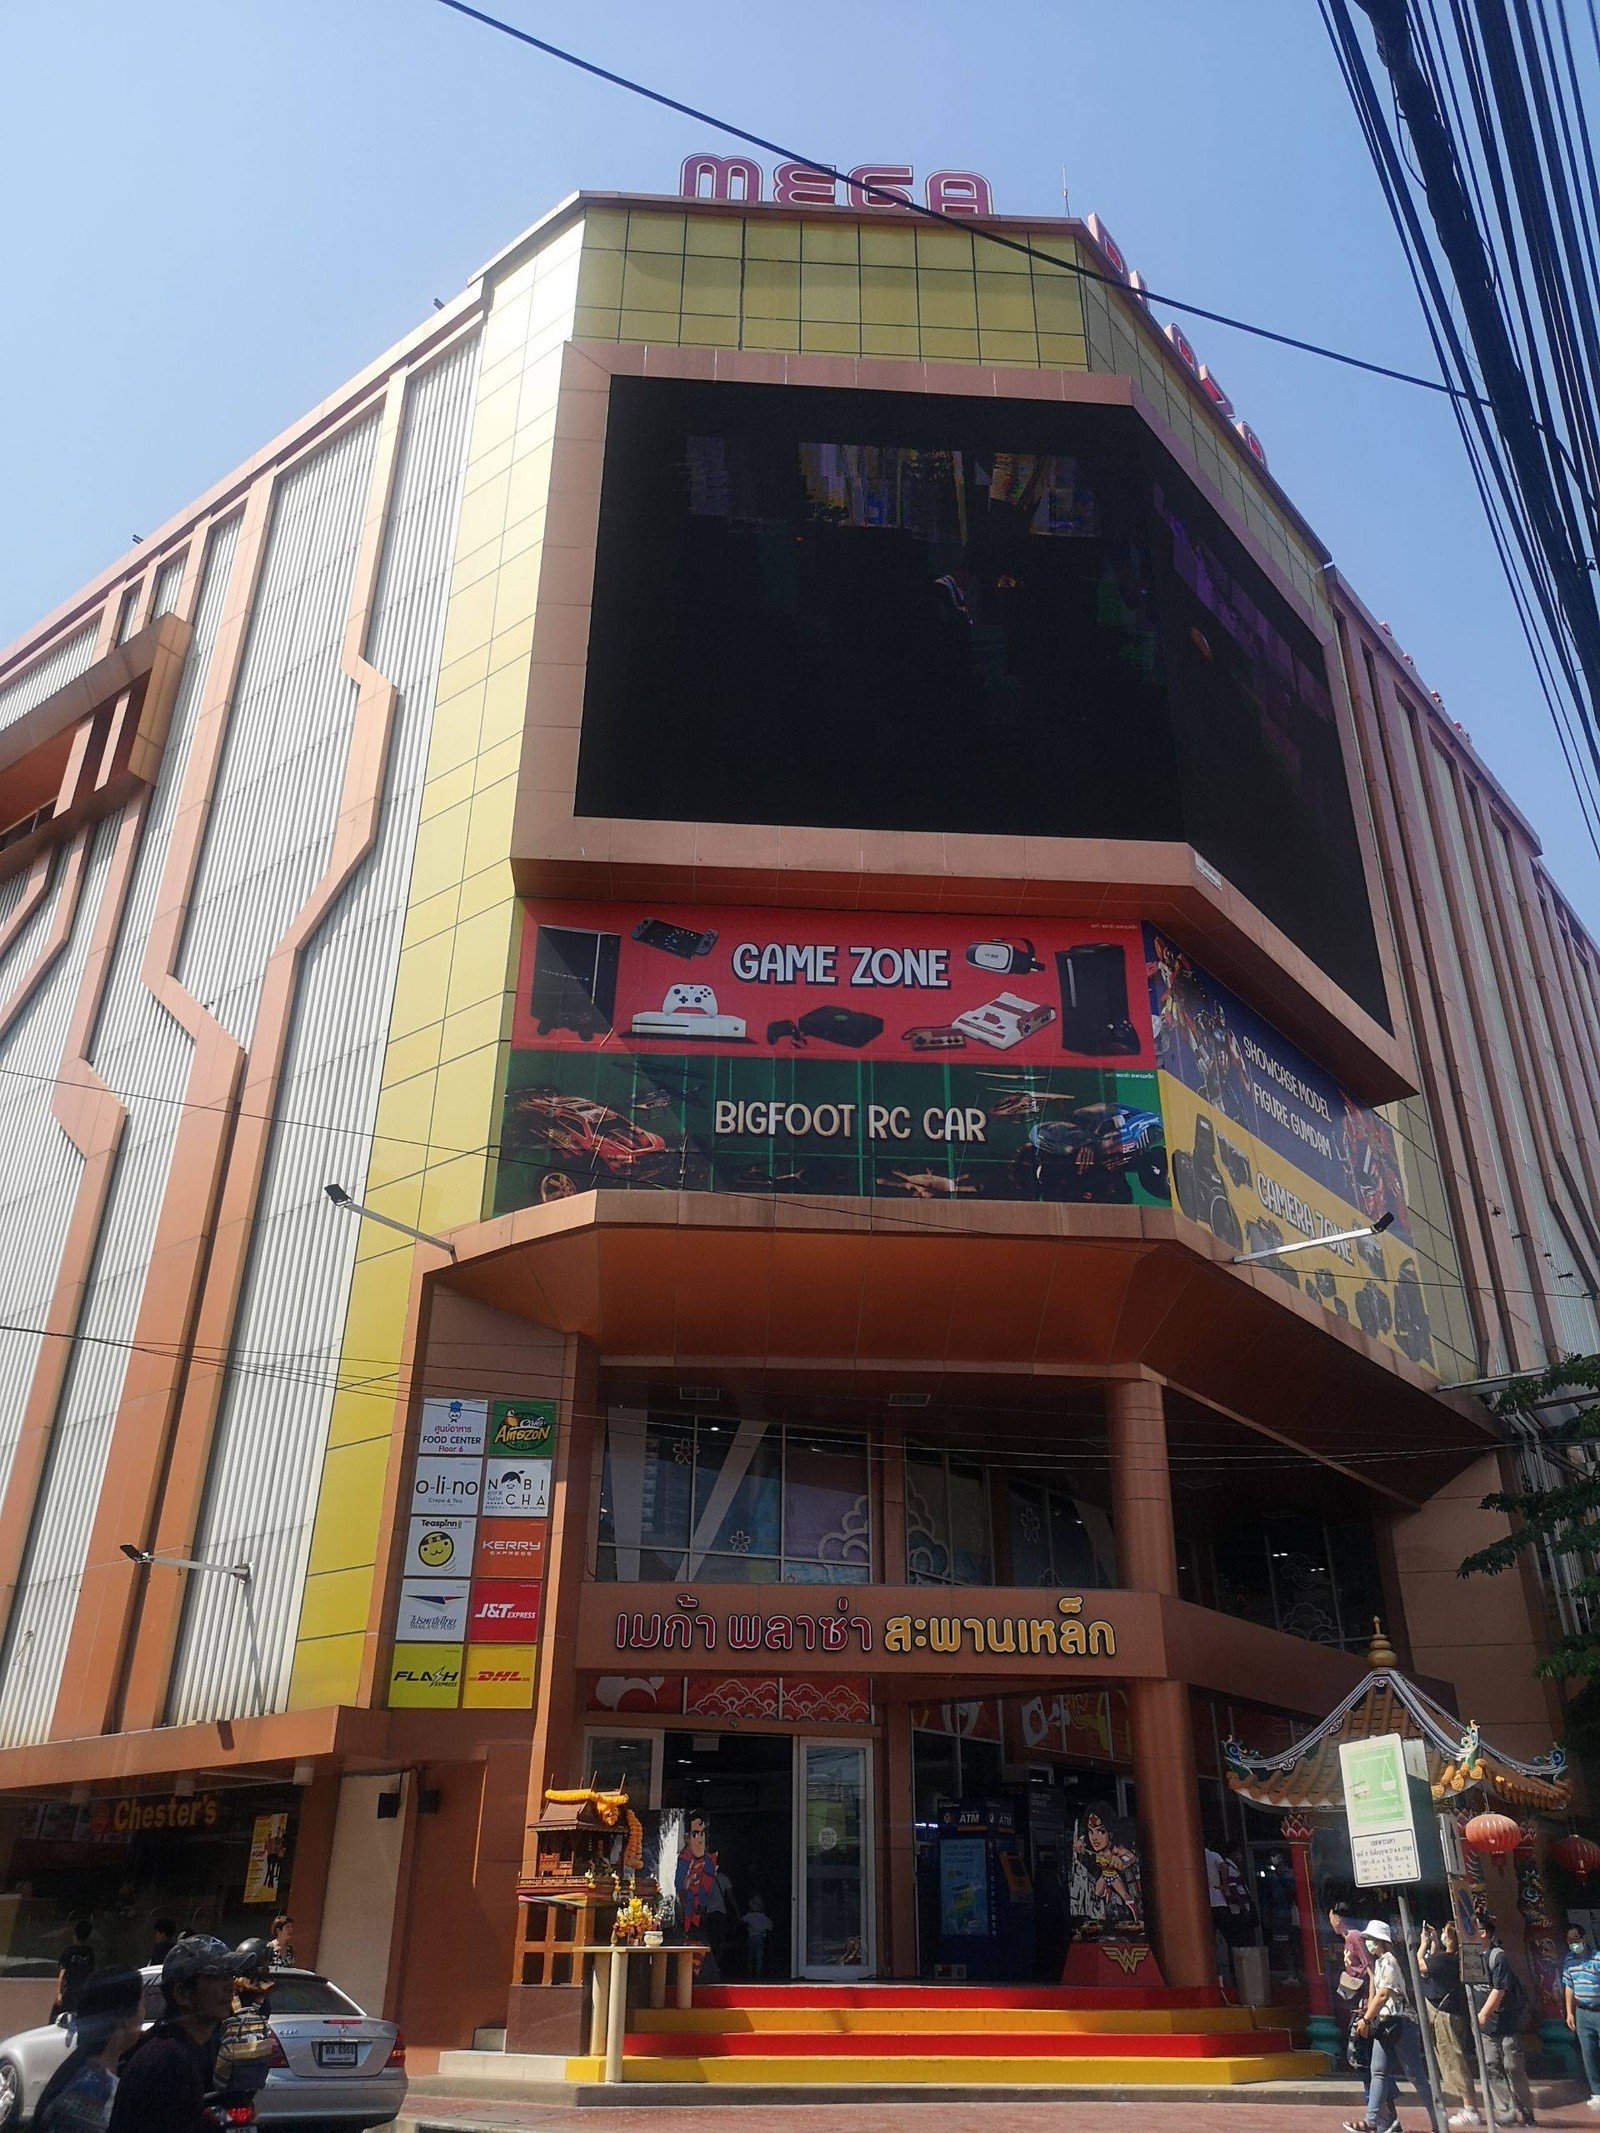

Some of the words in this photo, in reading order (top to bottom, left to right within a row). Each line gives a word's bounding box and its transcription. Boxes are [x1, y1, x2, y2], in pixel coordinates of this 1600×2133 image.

[680, 152, 993, 215] MEGA
[732, 942, 839, 986] GAME
[850, 945, 951, 989] ZONE
[1243, 1036, 1299, 1098] SHOWCASE
[1298, 1080, 1332, 1122] MODEL
[714, 1101, 856, 1140] BIGFOOT
[868, 1104, 912, 1139] RC
[923, 1106, 986, 1142] CAR
[1253, 1082, 1290, 1129] FIGURE
[1256, 1170, 1316, 1241] CAMERA
[1314, 1209, 1355, 1266] ZONE
[422, 1436, 447, 1444] FOOD
[450, 1436, 482, 1444] CENTER
[506, 1493, 545, 1505] CHA
[482, 1540, 541, 1551] KERRY
[474, 1603, 515, 1618] J&T
[507, 1611, 536, 1619] EXPRESS
[615, 1594, 718, 1651] เมก้า
[727, 1597, 873, 1653] พลาซ่า
[884, 1596, 1117, 1657] สะพานเหล็ก
[477, 1671, 522, 1682] DHL
[113, 1794, 218, 1831] Chester's
[959, 1813, 980, 1824] ATM
